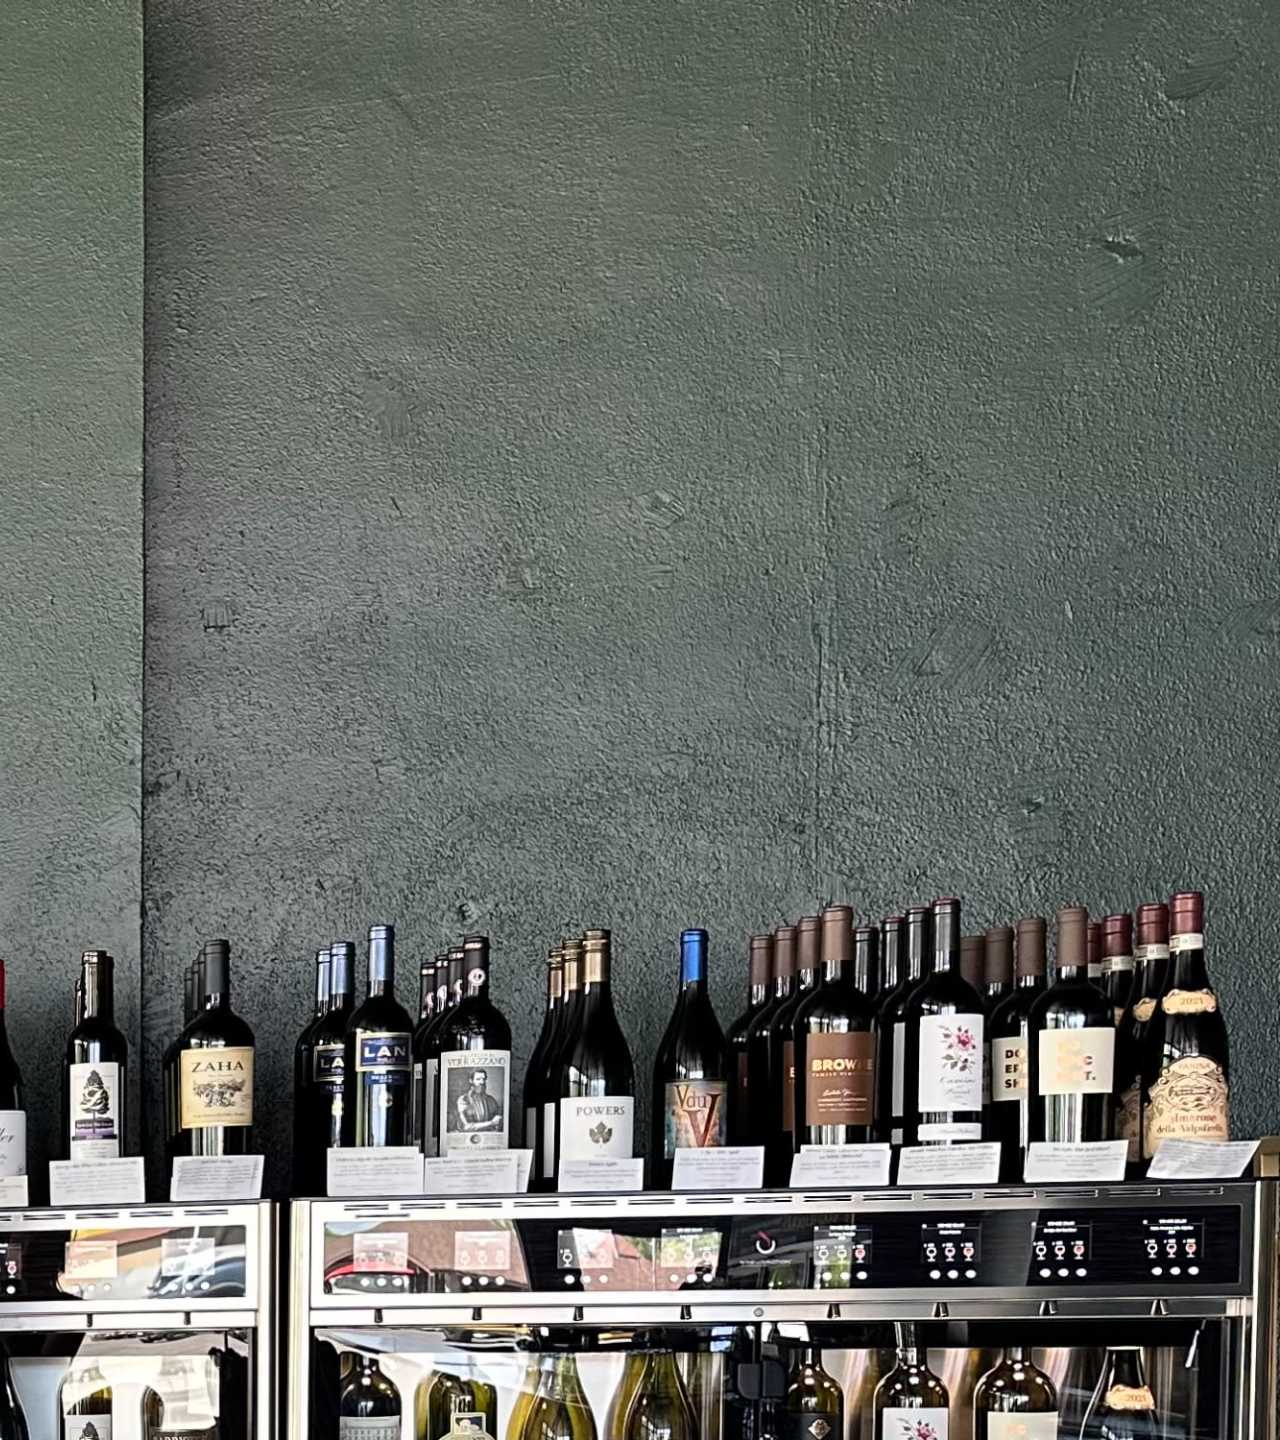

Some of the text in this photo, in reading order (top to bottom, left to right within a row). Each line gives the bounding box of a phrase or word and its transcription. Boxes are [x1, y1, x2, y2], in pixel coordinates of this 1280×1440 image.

[364, 1046, 406, 1058] LAN
[191, 1061, 245, 1073] ZAHA
[320, 1057, 345, 1069] LA
[811, 1058, 873, 1071] BROWE
[576, 1105, 626, 1116] POWERS
